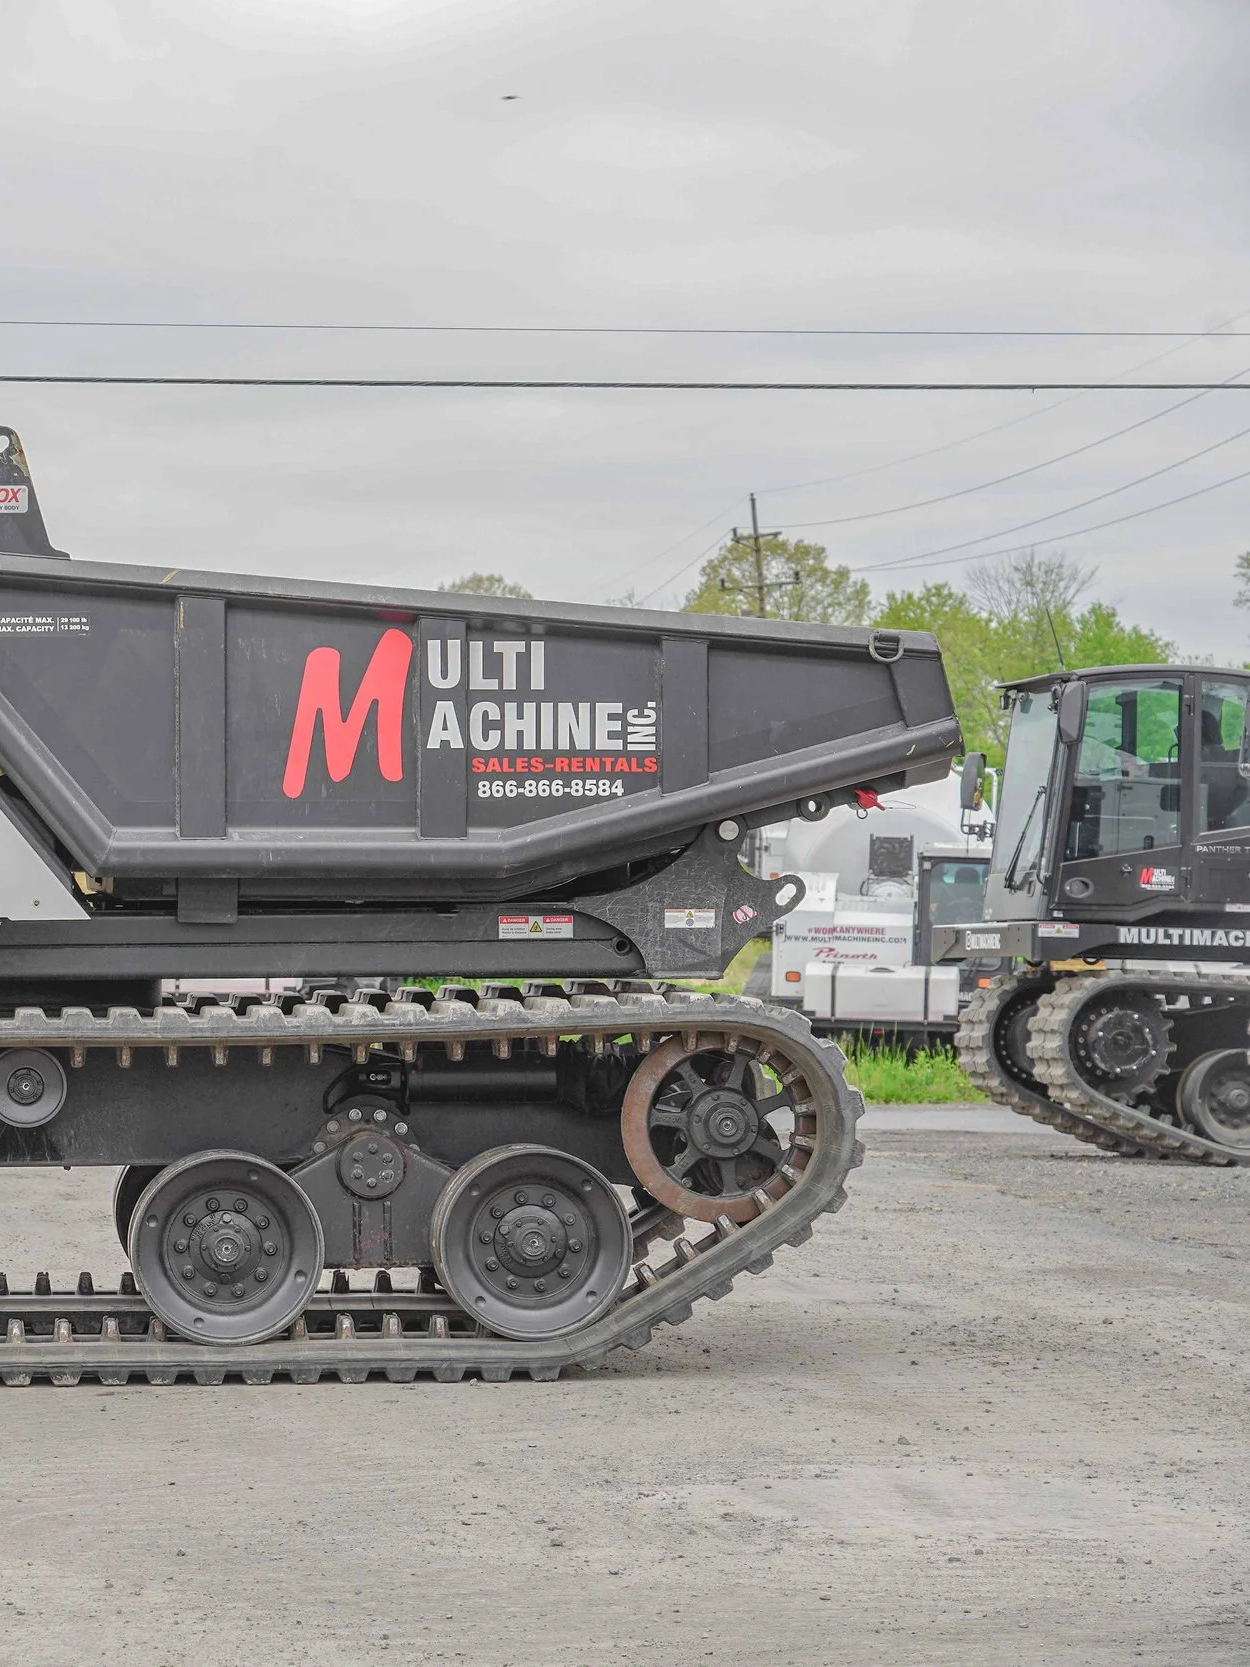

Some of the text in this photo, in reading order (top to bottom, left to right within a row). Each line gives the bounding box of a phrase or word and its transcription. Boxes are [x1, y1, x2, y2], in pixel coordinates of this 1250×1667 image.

[627, 701, 657, 751] INC.
[471, 757, 658, 773] SALES-RENTALS
[477, 779, 624, 798] 866-866-8584
[1195, 846, 1241, 854] PANTHER
[808, 926, 886, 935] #WORKANYWHERE
[1119, 928, 1250, 946] MULTIMAC
[812, 946, 878, 959] Prinoth
